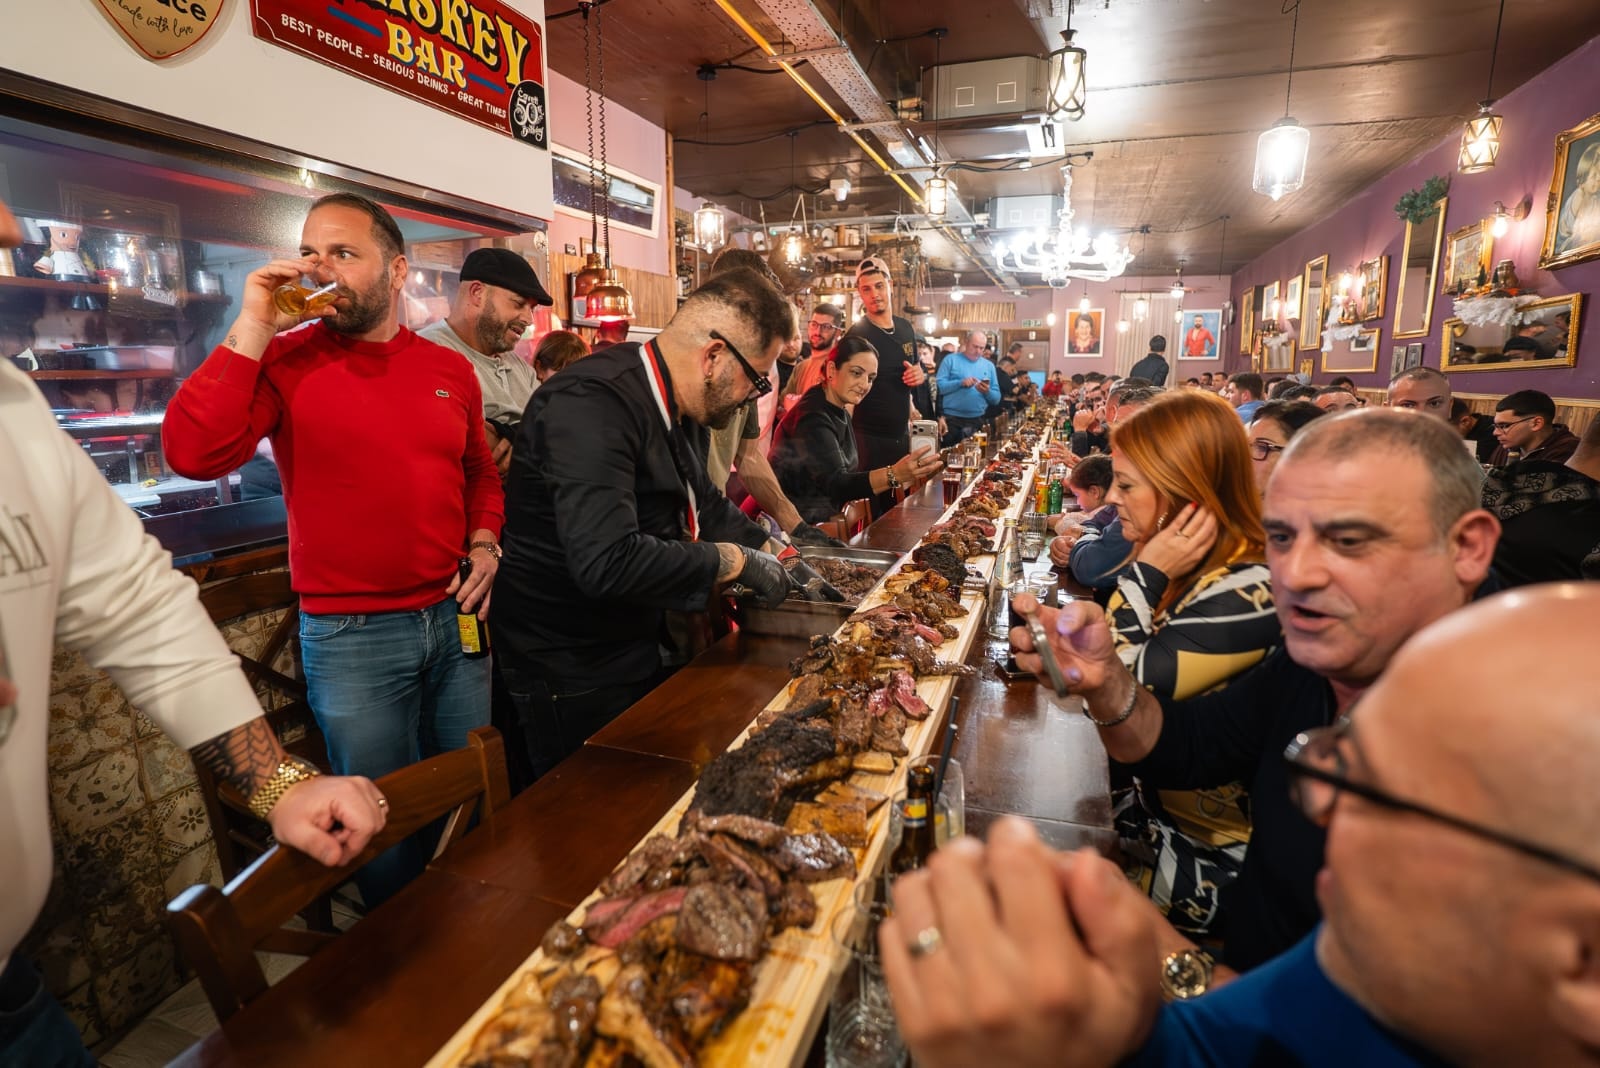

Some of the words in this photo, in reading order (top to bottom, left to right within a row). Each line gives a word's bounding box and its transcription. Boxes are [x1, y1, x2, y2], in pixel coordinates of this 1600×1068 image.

[147, 16, 169, 33] with
[173, 18, 193, 38] love
[385, 20, 467, 88] BAR
[281, 13, 312, 36] BEST
[317, 28, 363, 58] PEOPLE
[373, 53, 415, 80] SERIOUS
[417, 72, 449, 95] DRINKS
[458, 91, 484, 110] GREAT
[486, 102, 507, 119] TIMES
